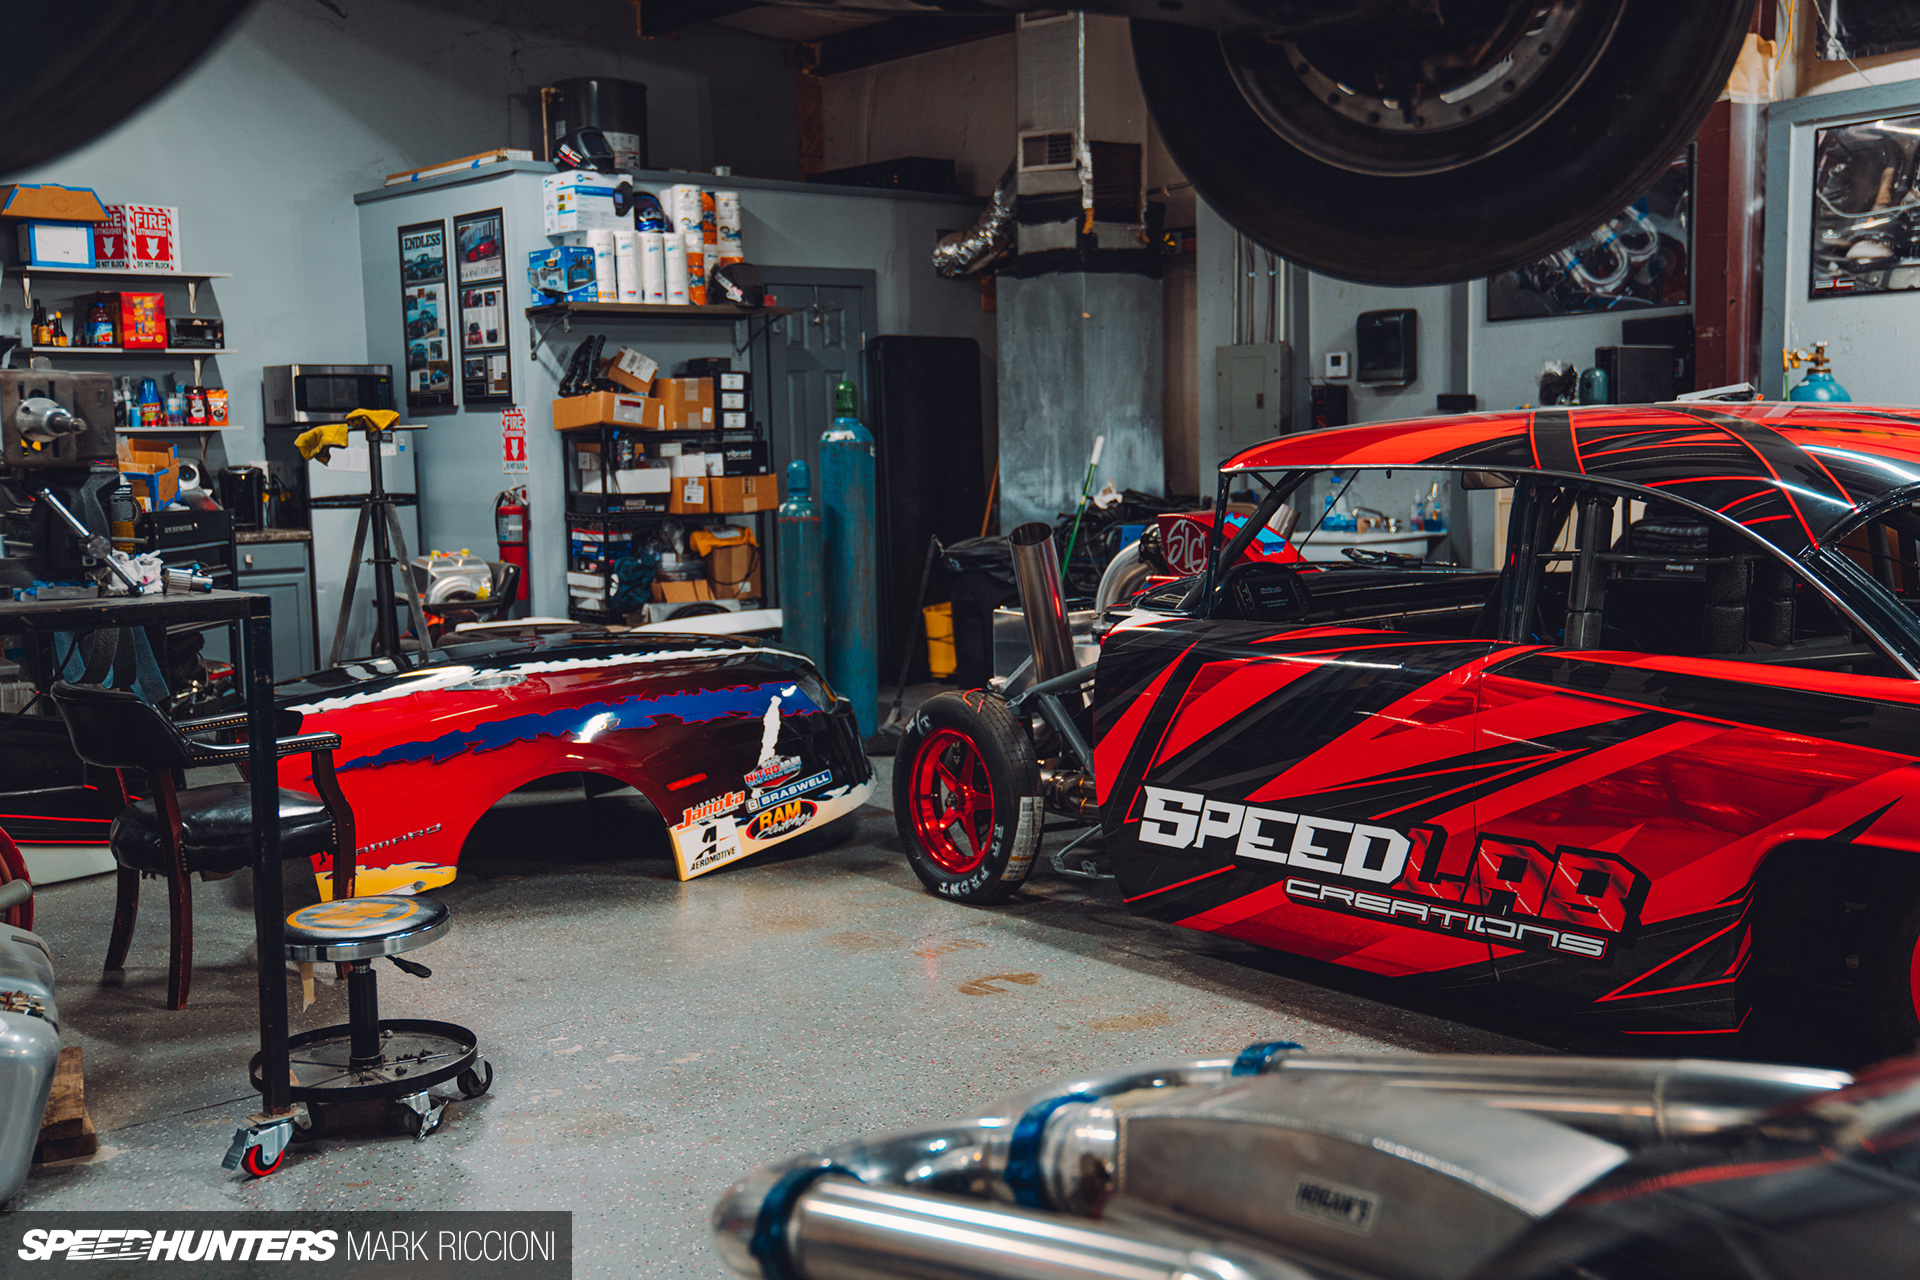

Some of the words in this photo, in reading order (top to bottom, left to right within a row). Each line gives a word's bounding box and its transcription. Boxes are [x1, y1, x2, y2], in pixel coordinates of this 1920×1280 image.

[135, 213, 167, 229] FIRE
[404, 233, 441, 251] ENDLESS
[102, 260, 111, 268] NOT
[111, 260, 125, 268] BLOCK
[145, 261, 154, 269] NOT
[505, 416, 523, 430] FIRE
[725, 449, 752, 458] vibrant
[760, 774, 829, 806] BRASWELL
[676, 791, 745, 831] Janota
[760, 799, 802, 831] RAM
[355, 822, 442, 856] AMARO
[690, 846, 736, 872] AEROMOTIVE
[1285, 877, 1607, 958] CREATIONS
